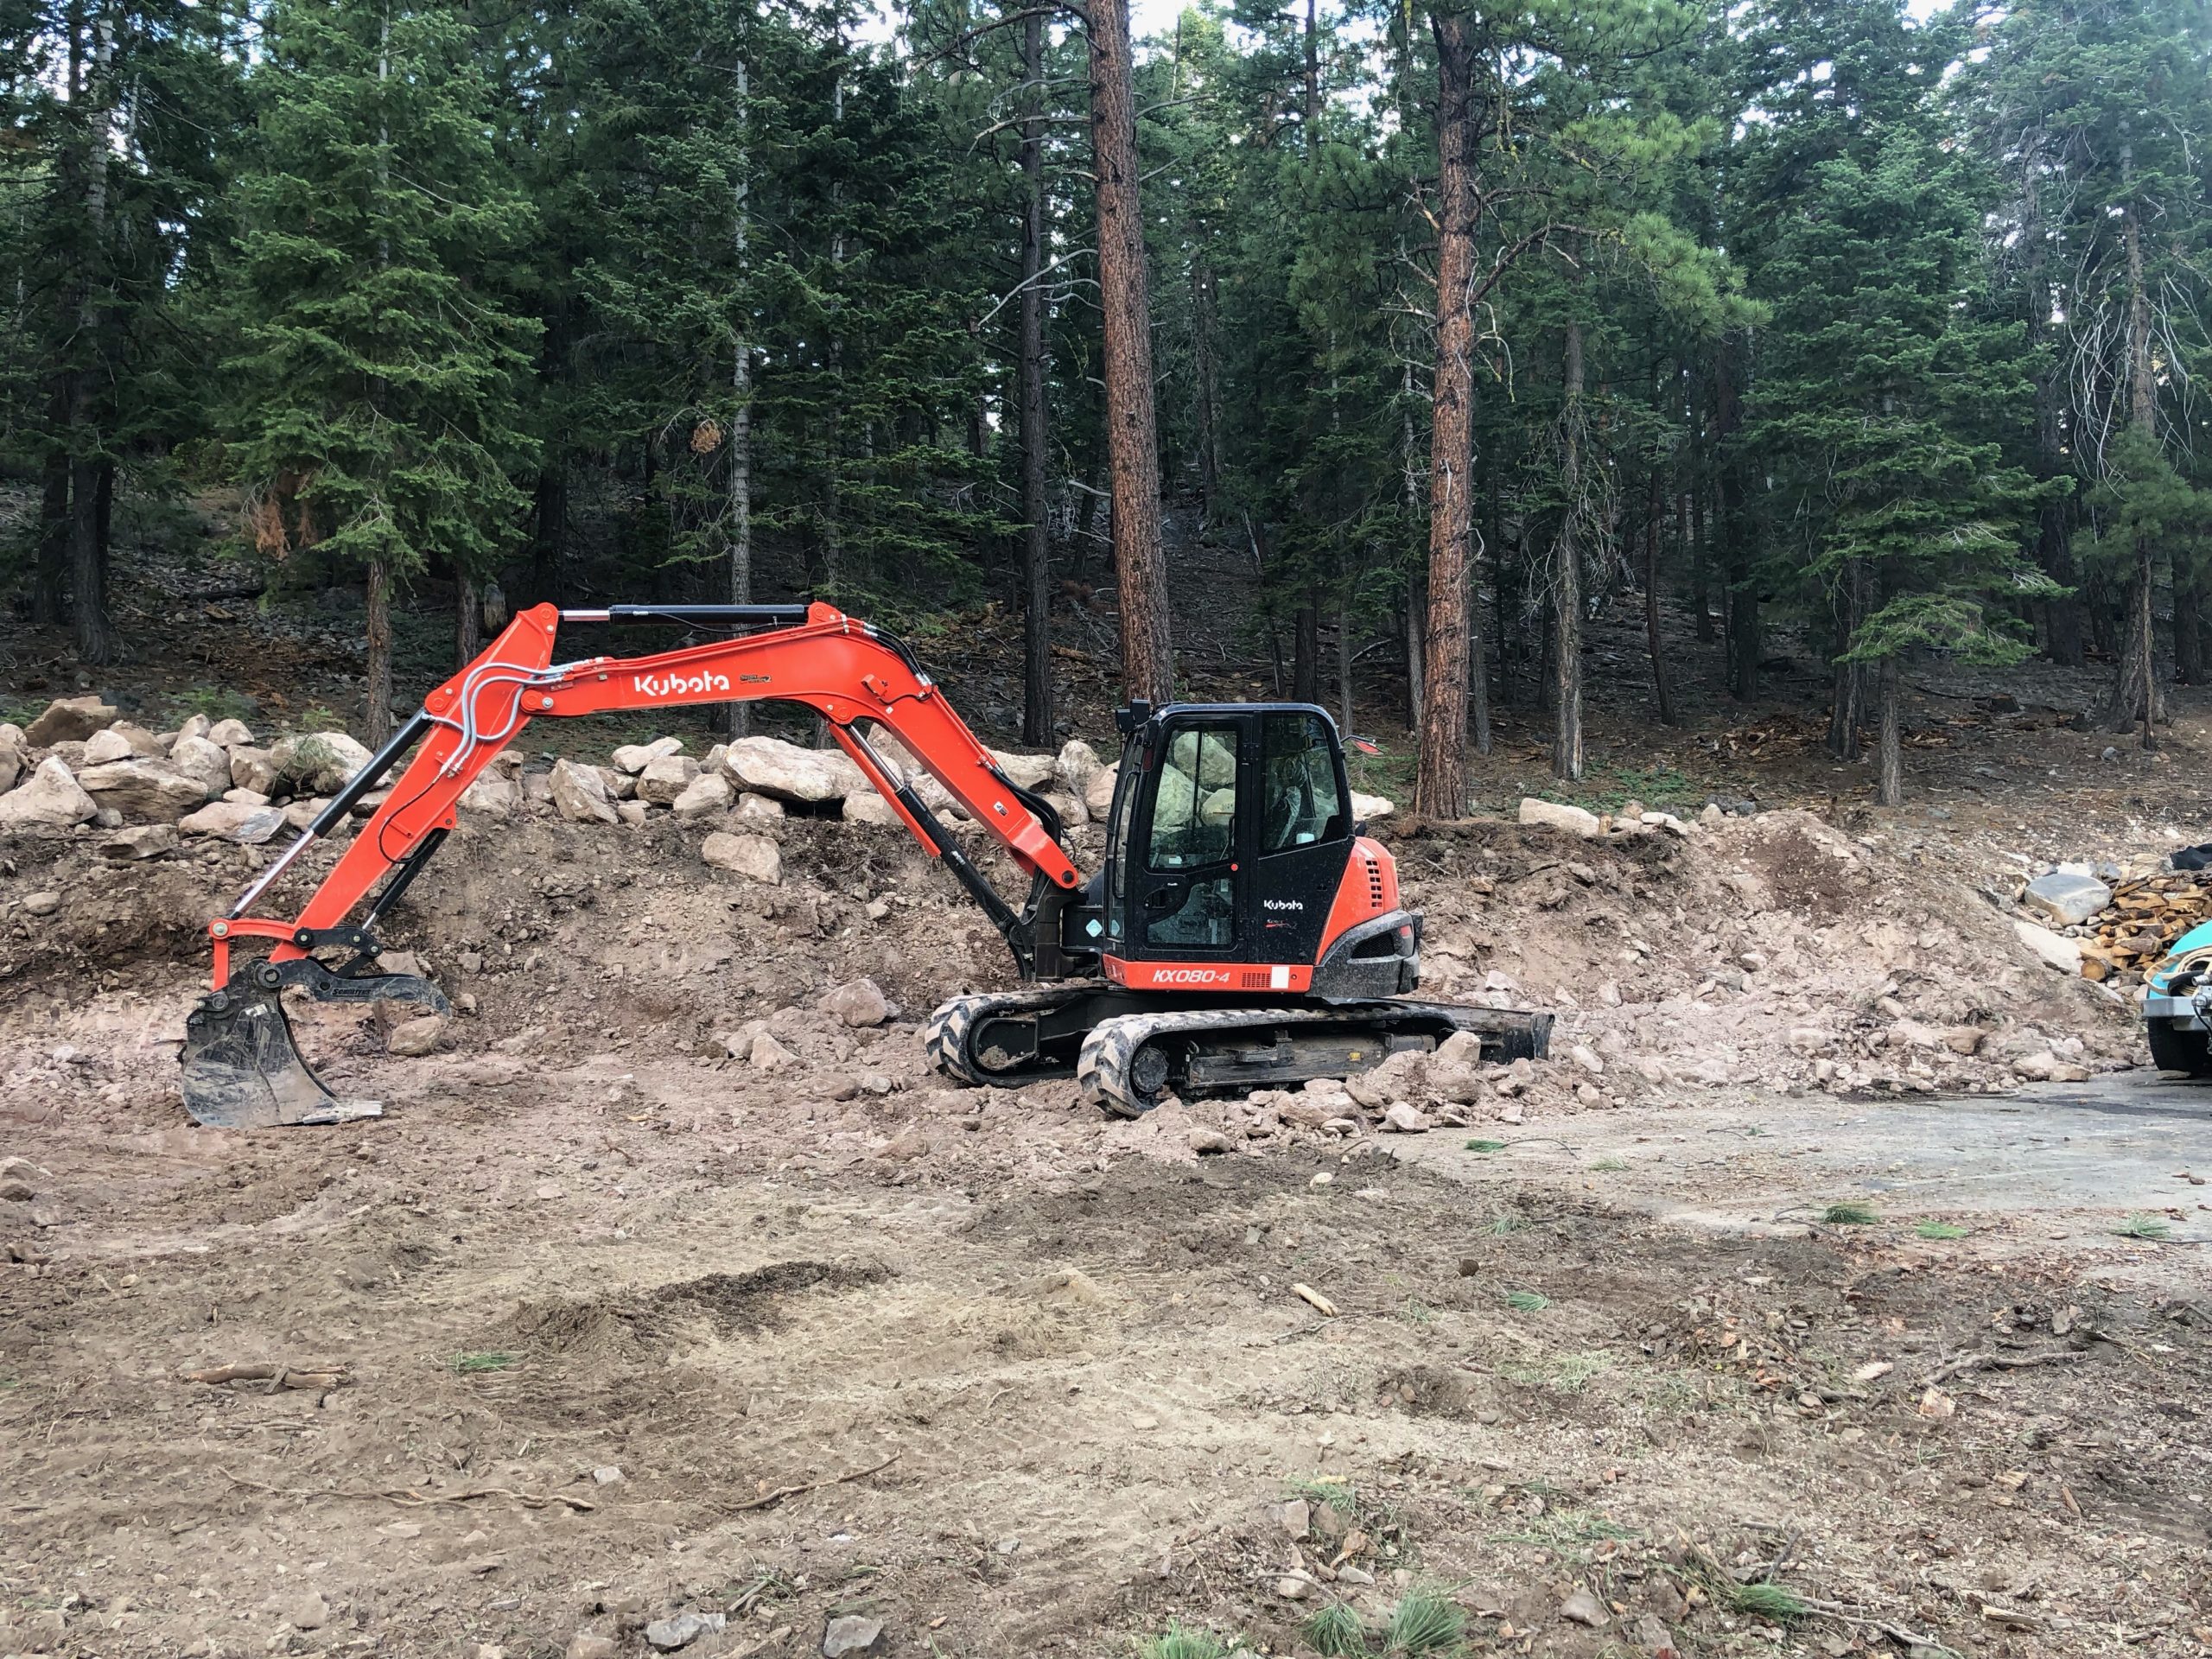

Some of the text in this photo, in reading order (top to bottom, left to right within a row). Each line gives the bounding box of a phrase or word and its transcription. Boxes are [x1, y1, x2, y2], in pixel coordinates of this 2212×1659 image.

[634, 671, 730, 696] Kubota
[1263, 899, 1304, 910] Kubota
[1152, 969, 1230, 983] KX080-4
